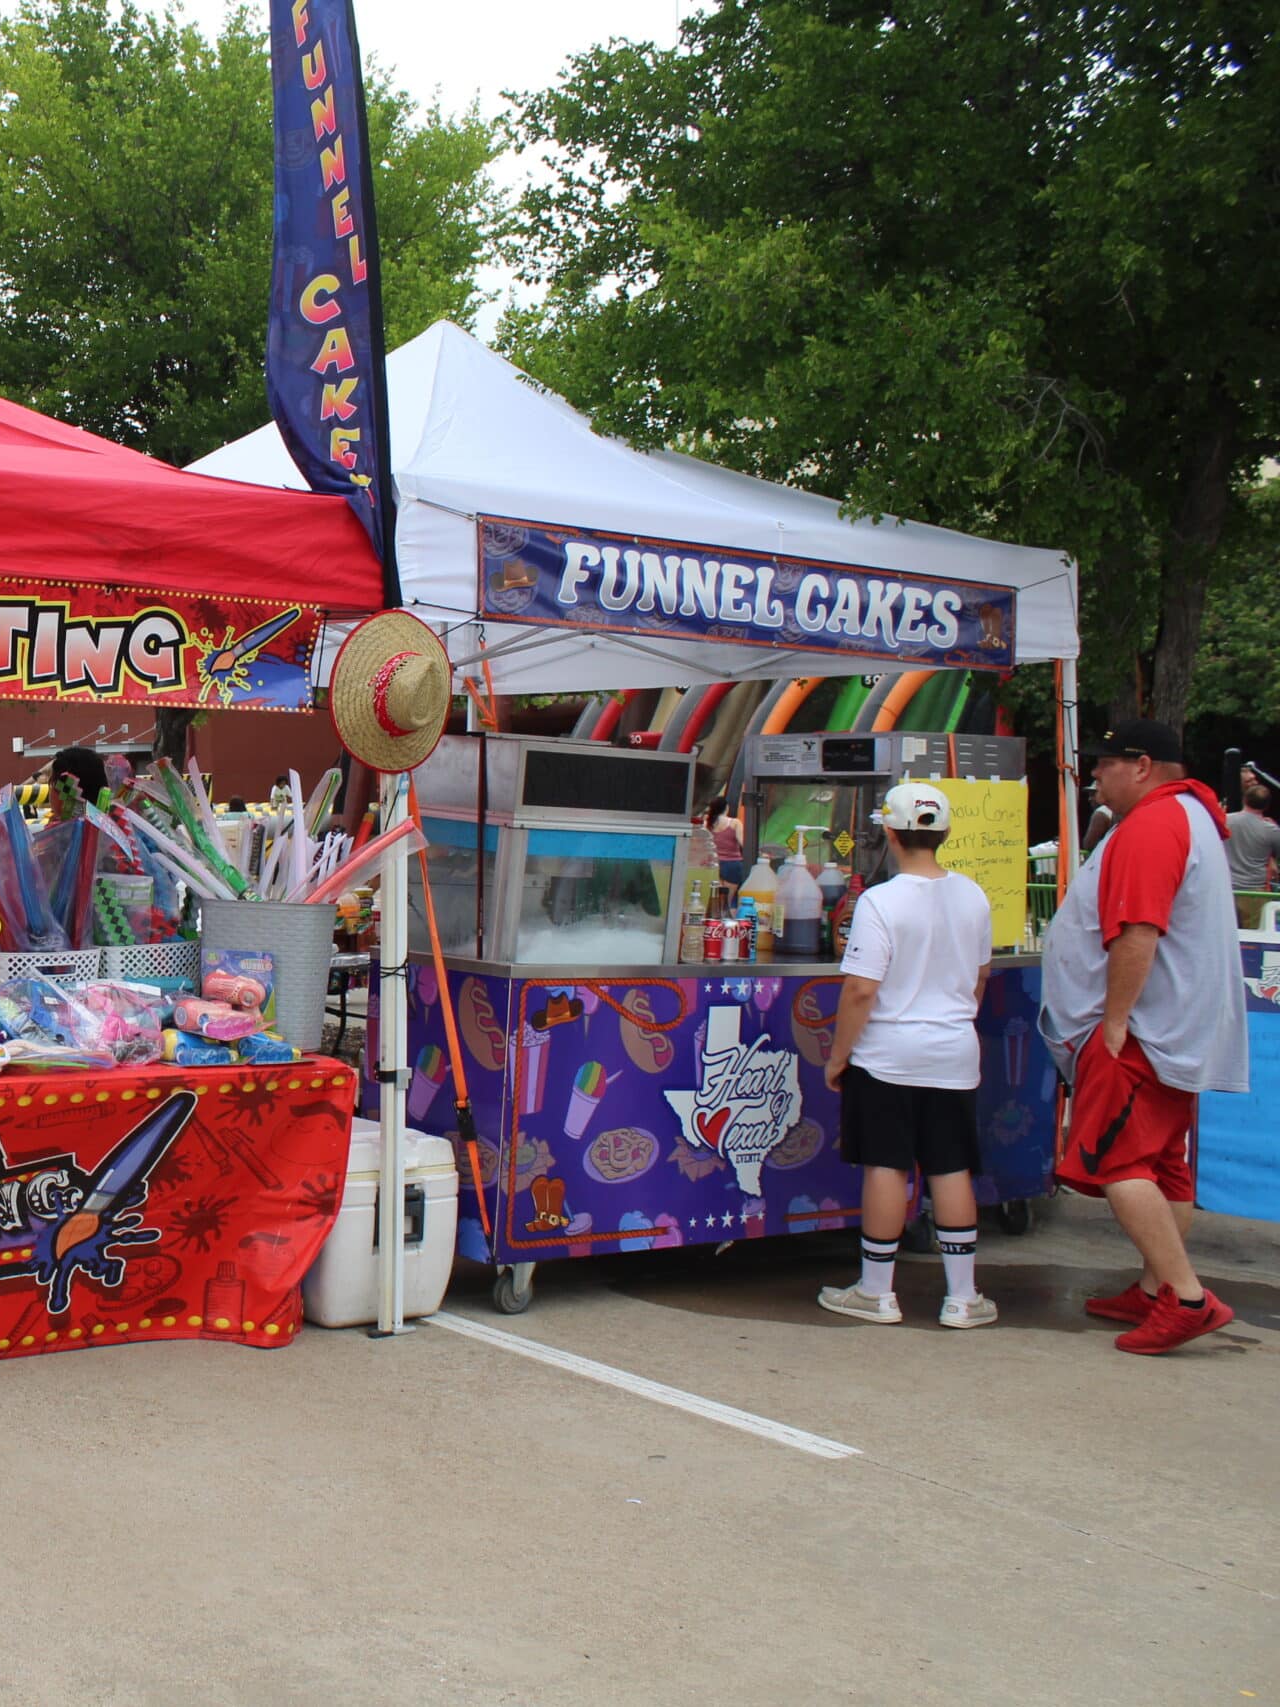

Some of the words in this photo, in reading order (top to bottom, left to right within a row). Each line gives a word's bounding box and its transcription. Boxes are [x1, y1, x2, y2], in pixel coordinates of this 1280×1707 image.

[291, 0, 367, 285] FUNNEL
[557, 541, 784, 629] FUNNEL
[795, 572, 963, 650] CAKES
[695, 1033, 792, 1107] Heart
[692, 1094, 781, 1159] Texas
